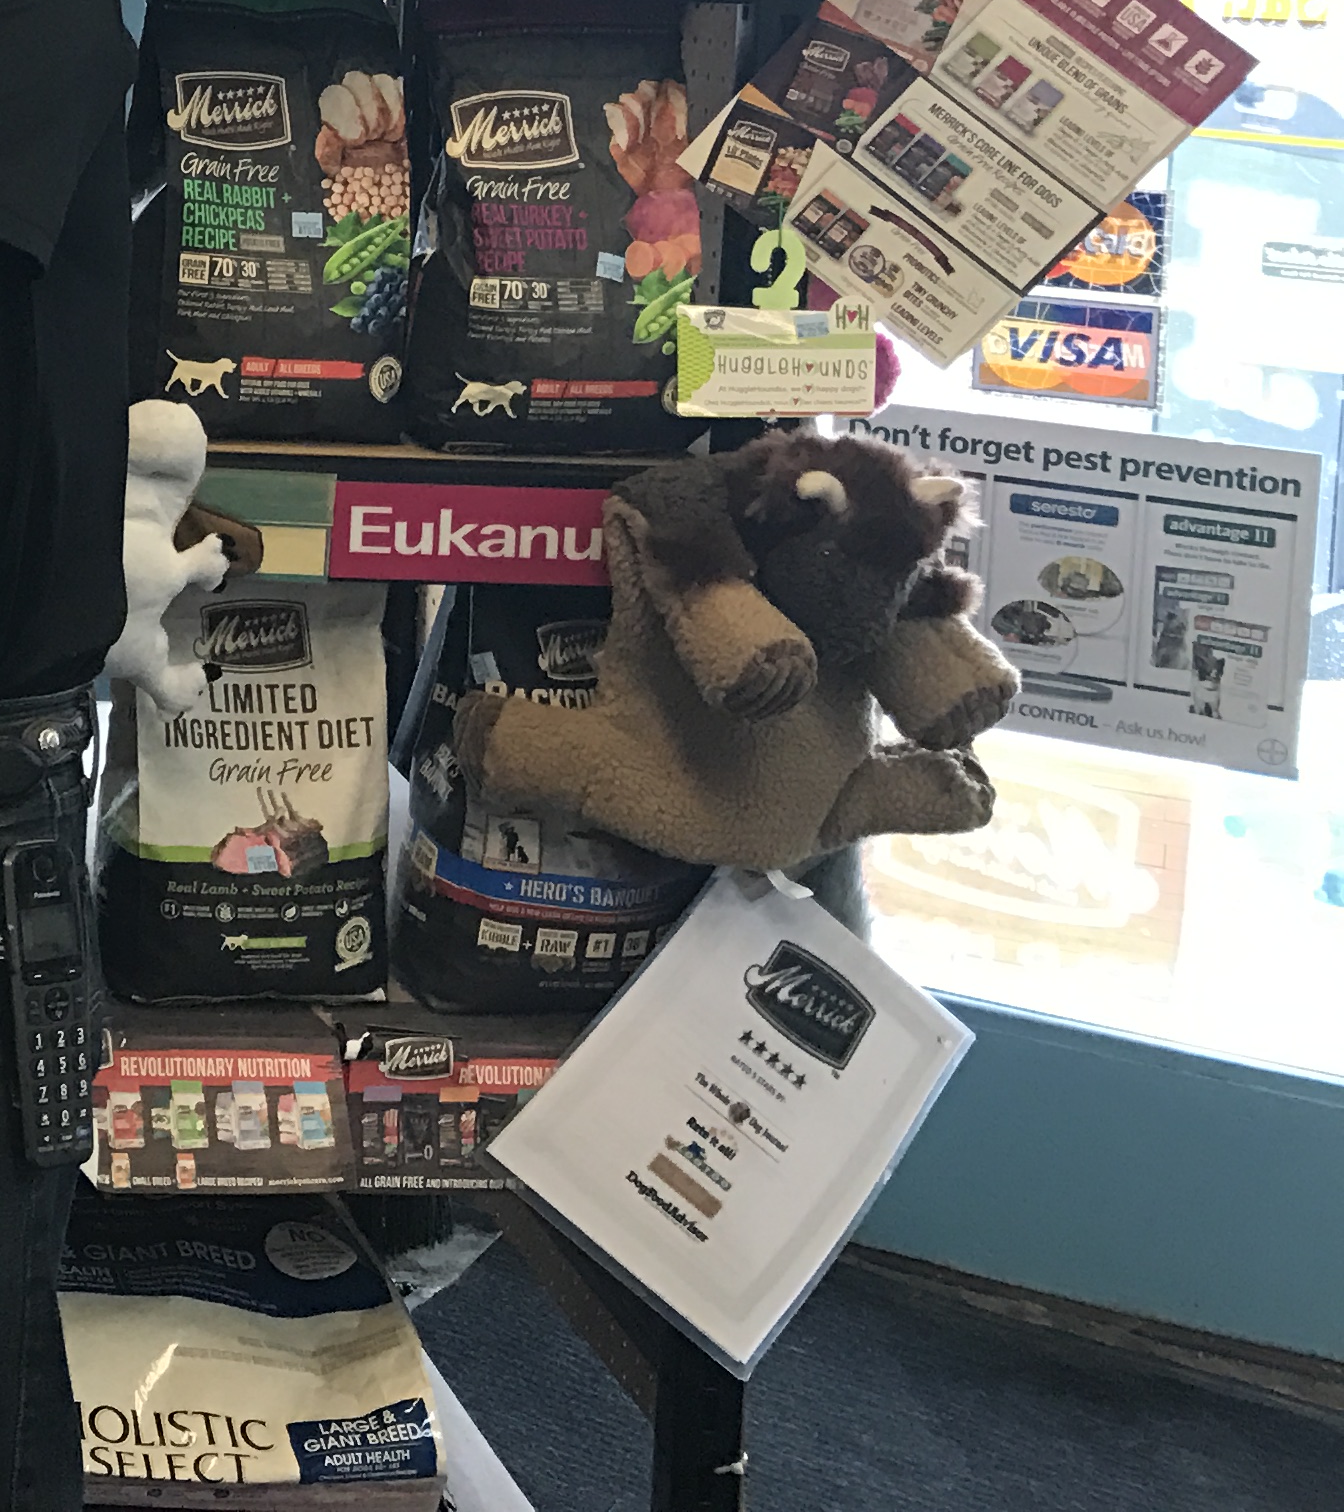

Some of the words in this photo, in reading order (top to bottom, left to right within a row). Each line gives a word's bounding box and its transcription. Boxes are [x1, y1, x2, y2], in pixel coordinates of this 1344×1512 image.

[167, 84, 278, 131] Merrick
[180, 152, 231, 182] Grain
[234, 159, 280, 183] Free
[928, 102, 977, 144] MERRICK'S
[973, 136, 1002, 166] CORE
[1000, 156, 1022, 179] LINE
[1019, 169, 1041, 194] FOR
[1034, 180, 1063, 208] DOGS
[183, 178, 220, 204] REAL
[222, 185, 276, 209] RABBIT
[182, 202, 265, 231] CHICKPEAS
[181, 226, 238, 251] RECIPE
[1004, 326, 1125, 372] VISA
[937, 427, 1035, 465] forget
[1041, 446, 1112, 474] pest
[1119, 456, 1302, 498] prevention
[1030, 498, 1099, 519] seresto
[348, 504, 606, 563] Eukanu
[1169, 517, 1250, 542] advantage
[1253, 526, 1270, 544] II
[209, 683, 318, 715] LIMITED
[165, 717, 309, 751] INGREDIENT
[318, 716, 375, 749] DIET
[1018, 703, 1099, 729] CONTROL
[1115, 717, 1143, 736] Ask
[1146, 724, 1165, 738] us
[1167, 724, 1207, 747] how!
[209, 757, 272, 785] Grain
[276, 758, 335, 786] Free
[120, 1056, 234, 1078] REVOLUTIONARY
[237, 1057, 312, 1079] NUTRITION
[303, 1432, 364, 1452] GIANT
[367, 1423, 421, 1444] BREED
[319, 1416, 379, 1435] LARGE
[383, 1410, 397, 1424] &
[88, 1446, 252, 1484] SELECT
[324, 1450, 362, 1468] ADULT
[365, 1449, 410, 1464] HEALTH
